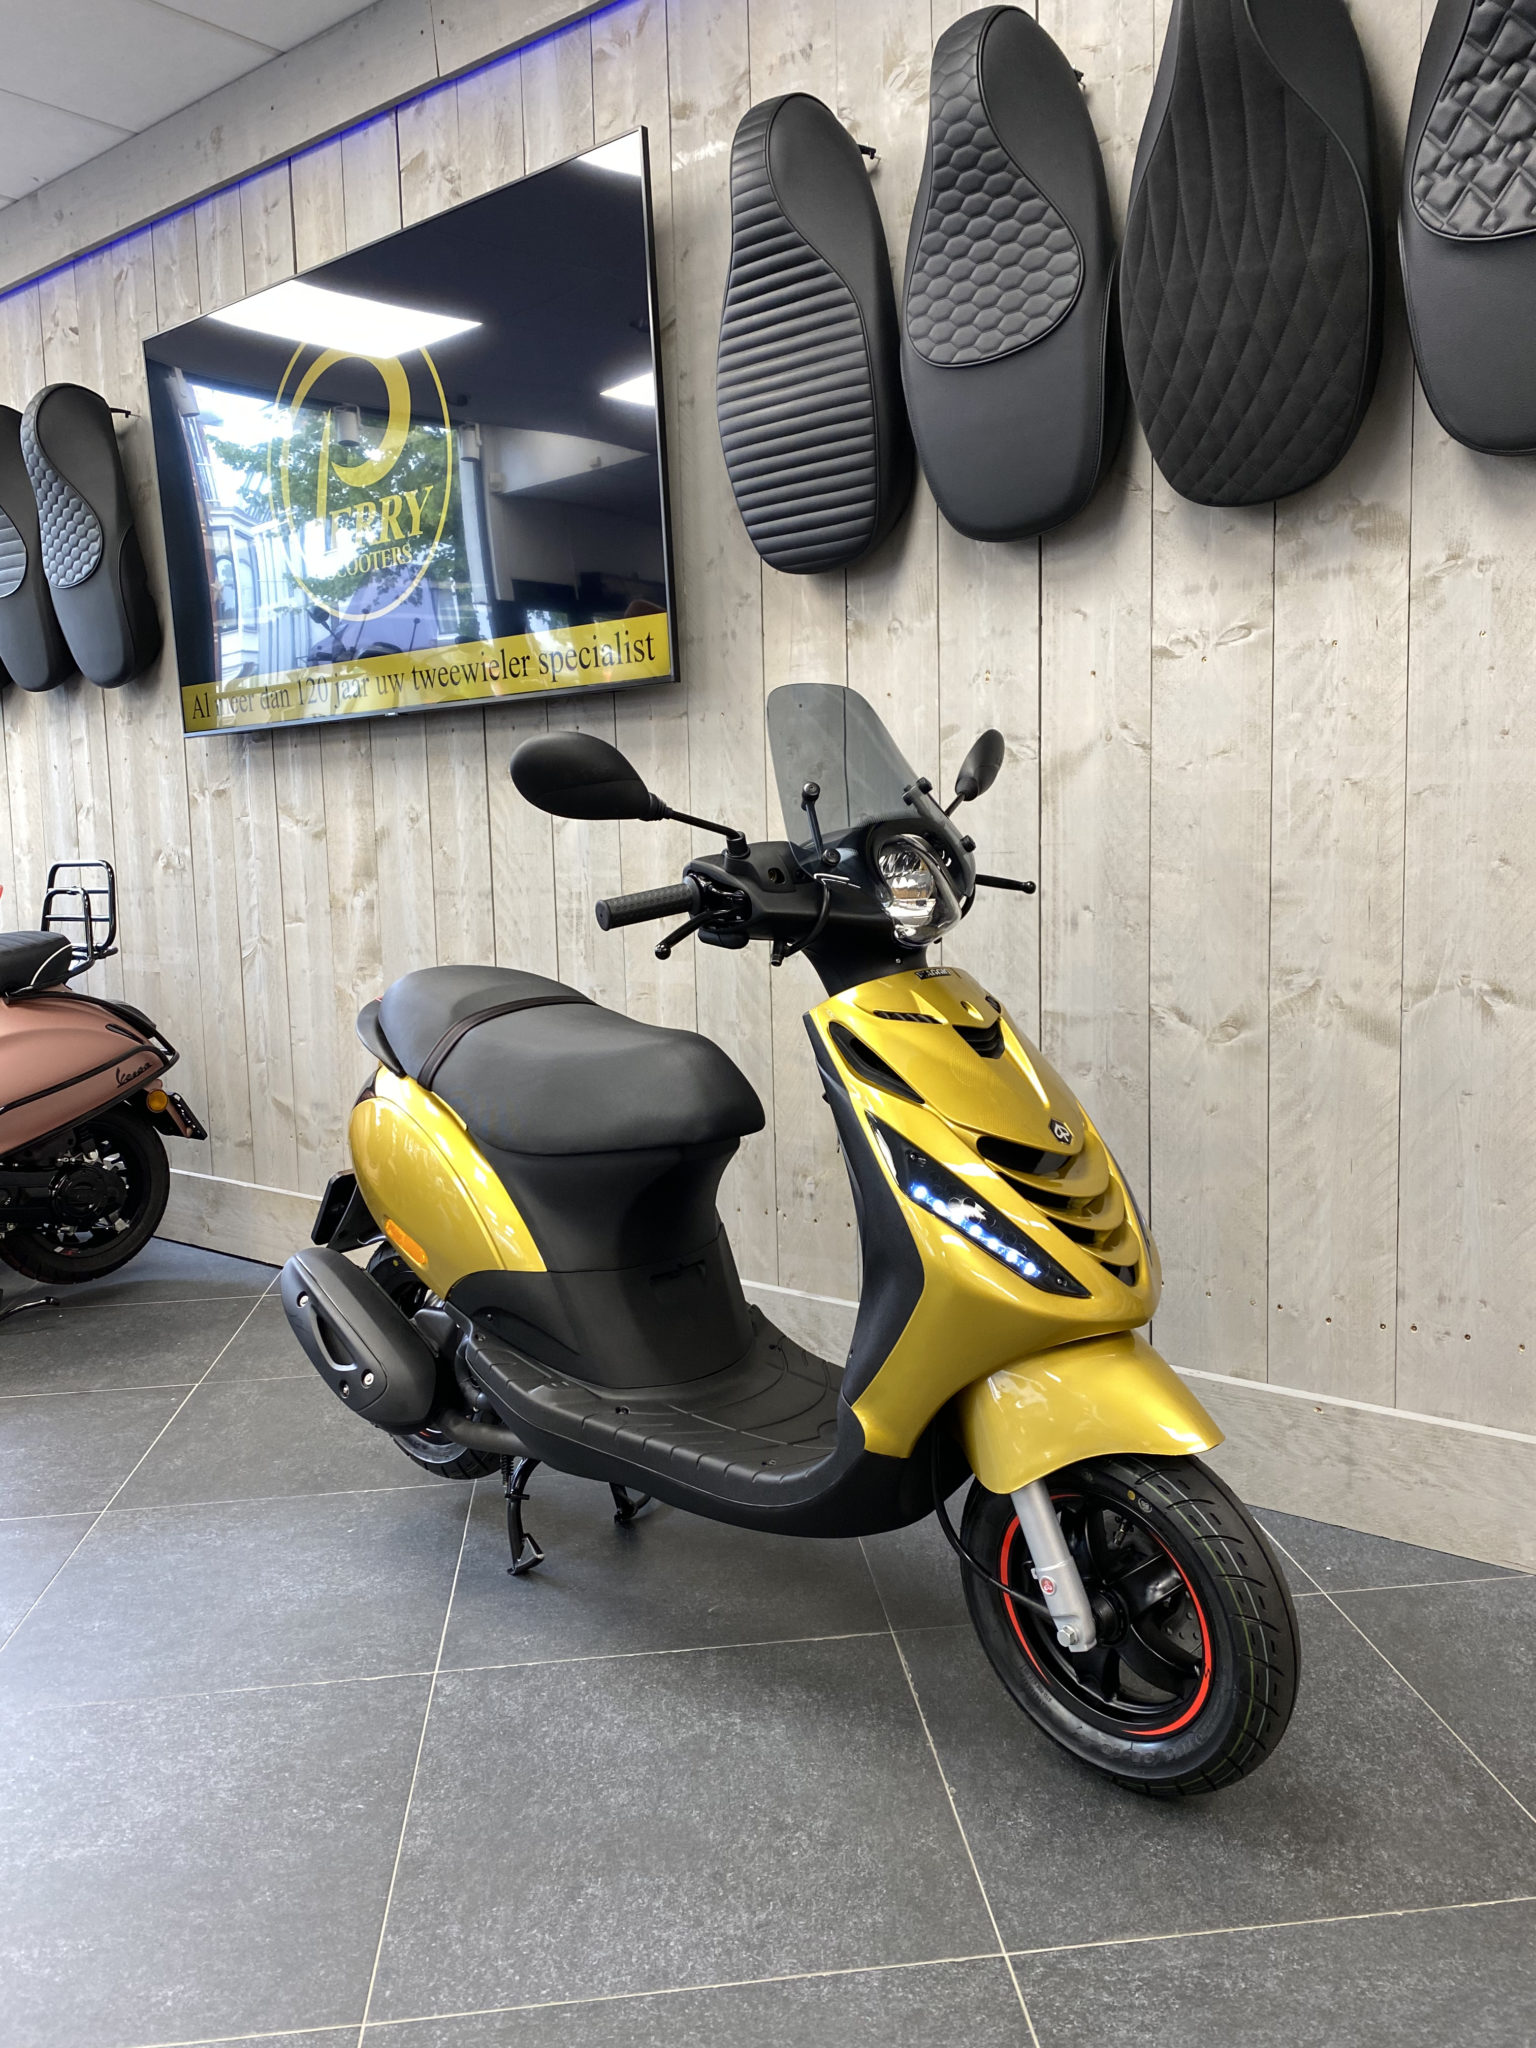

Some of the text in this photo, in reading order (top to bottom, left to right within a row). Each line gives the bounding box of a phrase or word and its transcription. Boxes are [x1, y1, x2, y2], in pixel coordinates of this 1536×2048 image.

[328, 544, 413, 579] COOTERS
[192, 691, 211, 720] Al
[260, 686, 289, 709] dan
[299, 676, 328, 706] 120
[333, 673, 370, 709] jaar
[376, 673, 405, 695] uw
[411, 648, 531, 691] tweewieler
[539, 630, 656, 682] specialist
